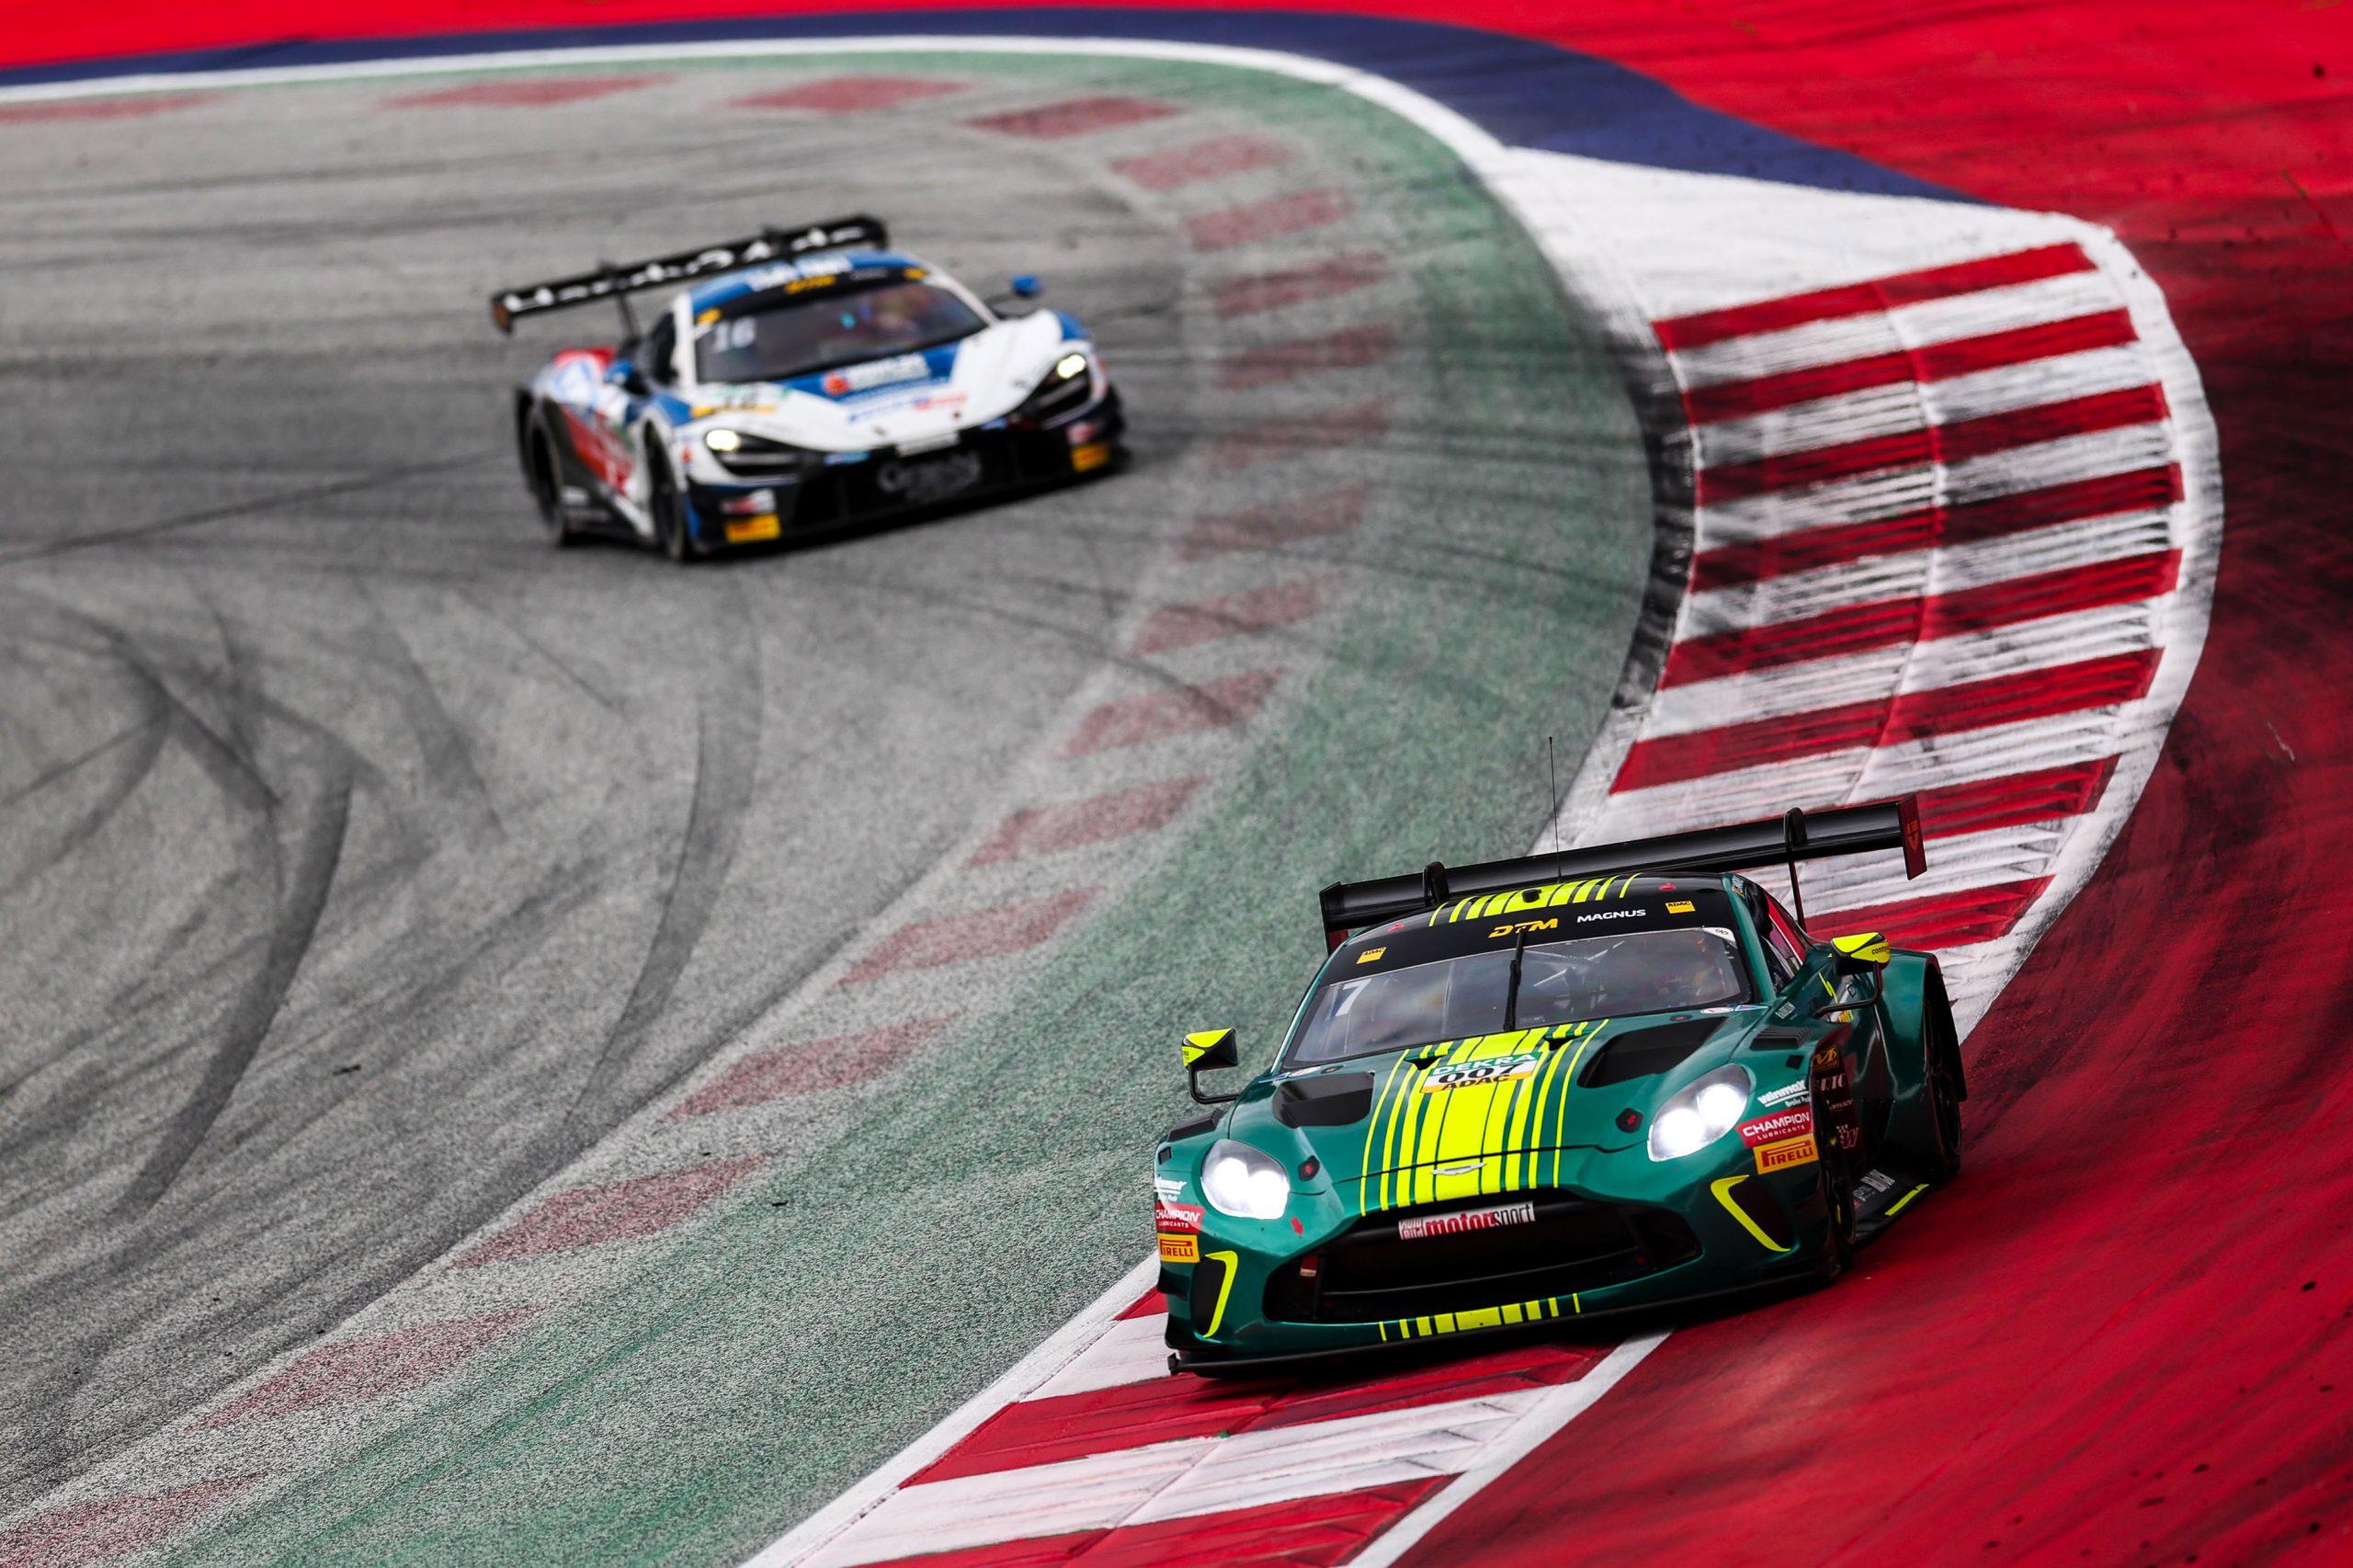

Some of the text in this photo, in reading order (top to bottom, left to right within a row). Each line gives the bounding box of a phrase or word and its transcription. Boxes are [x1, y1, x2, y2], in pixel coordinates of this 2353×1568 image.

[1577, 909, 1646, 923] MAGNUS
[1488, 918, 1559, 938] DTM
[1432, 1053, 1537, 1075] DEKRA
[1438, 1062, 1525, 1085] 007
[1441, 1074, 1509, 1091] ADAC
[1743, 1112, 1811, 1137] CHAMPION
[1757, 1125, 1805, 1141] LUBRICANTS
[1761, 1140, 1814, 1168] PIRELLI
[1155, 1210, 1200, 1223] CHAMPION
